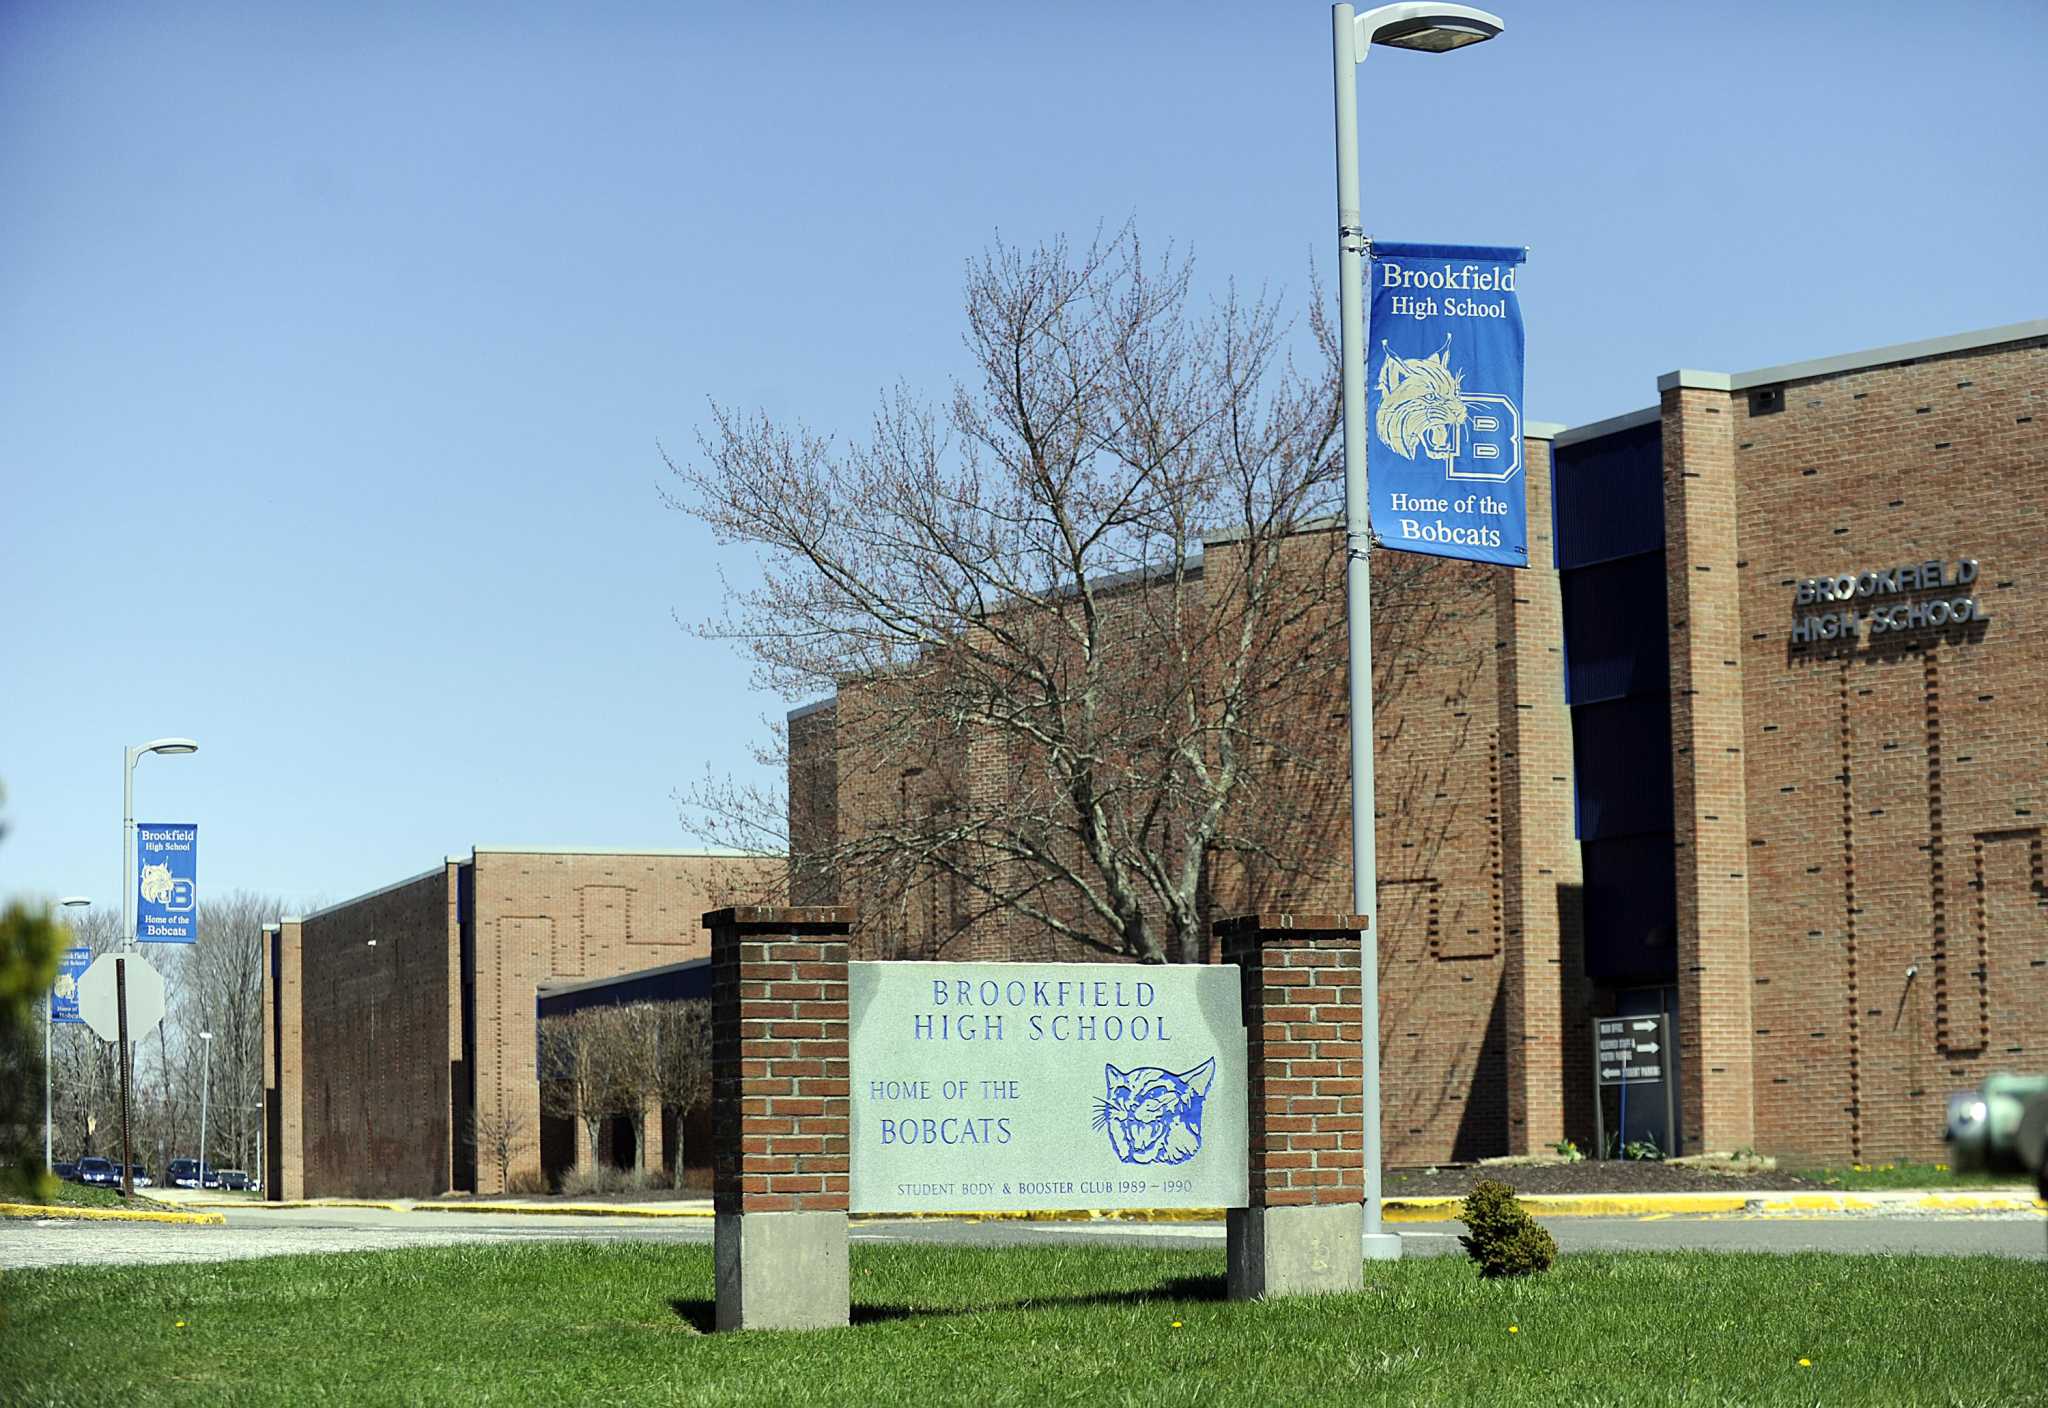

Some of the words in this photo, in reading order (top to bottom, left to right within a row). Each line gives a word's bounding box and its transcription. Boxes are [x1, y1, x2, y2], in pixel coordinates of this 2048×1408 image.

[1382, 263, 1516, 292] Brookfield
[1391, 296, 1438, 320] High
[1444, 297, 1506, 318] School
[1391, 493, 1448, 512] Home
[1454, 494, 1475, 513] of
[1479, 496, 1508, 515] the
[1400, 519, 1501, 547] Bobcats
[1797, 559, 1979, 605] BROOKFIELD
[1792, 611, 1861, 643] HIGH
[1871, 598, 1990, 633] SCHOOL
[142, 830, 194, 841] Brookfield
[145, 842, 164, 852] High
[165, 842, 190, 851] School
[145, 915, 167, 924] Home
[168, 915, 177, 924] of
[178, 916, 190, 924] the
[147, 926, 187, 936] Bobcats
[932, 980, 1155, 1007] BROOKFIELD
[914, 1014, 1004, 1041] HIGH
[1029, 1015, 1172, 1041] SCHOOL
[870, 1081, 930, 1100] HOME
[943, 1081, 968, 1099] OF
[982, 1081, 1021, 1099] THE
[880, 1118, 1012, 1145] BOBCATS
[897, 1183, 955, 1196] STUDENT
[962, 1183, 994, 1195] BODY
[1002, 1182, 1012, 1195] &
[1019, 1182, 1073, 1194] BOOSTER
[1080, 1181, 1113, 1194] CLUB
[1118, 1181, 1146, 1193] 1989
[1162, 1181, 1192, 1193] 1990
